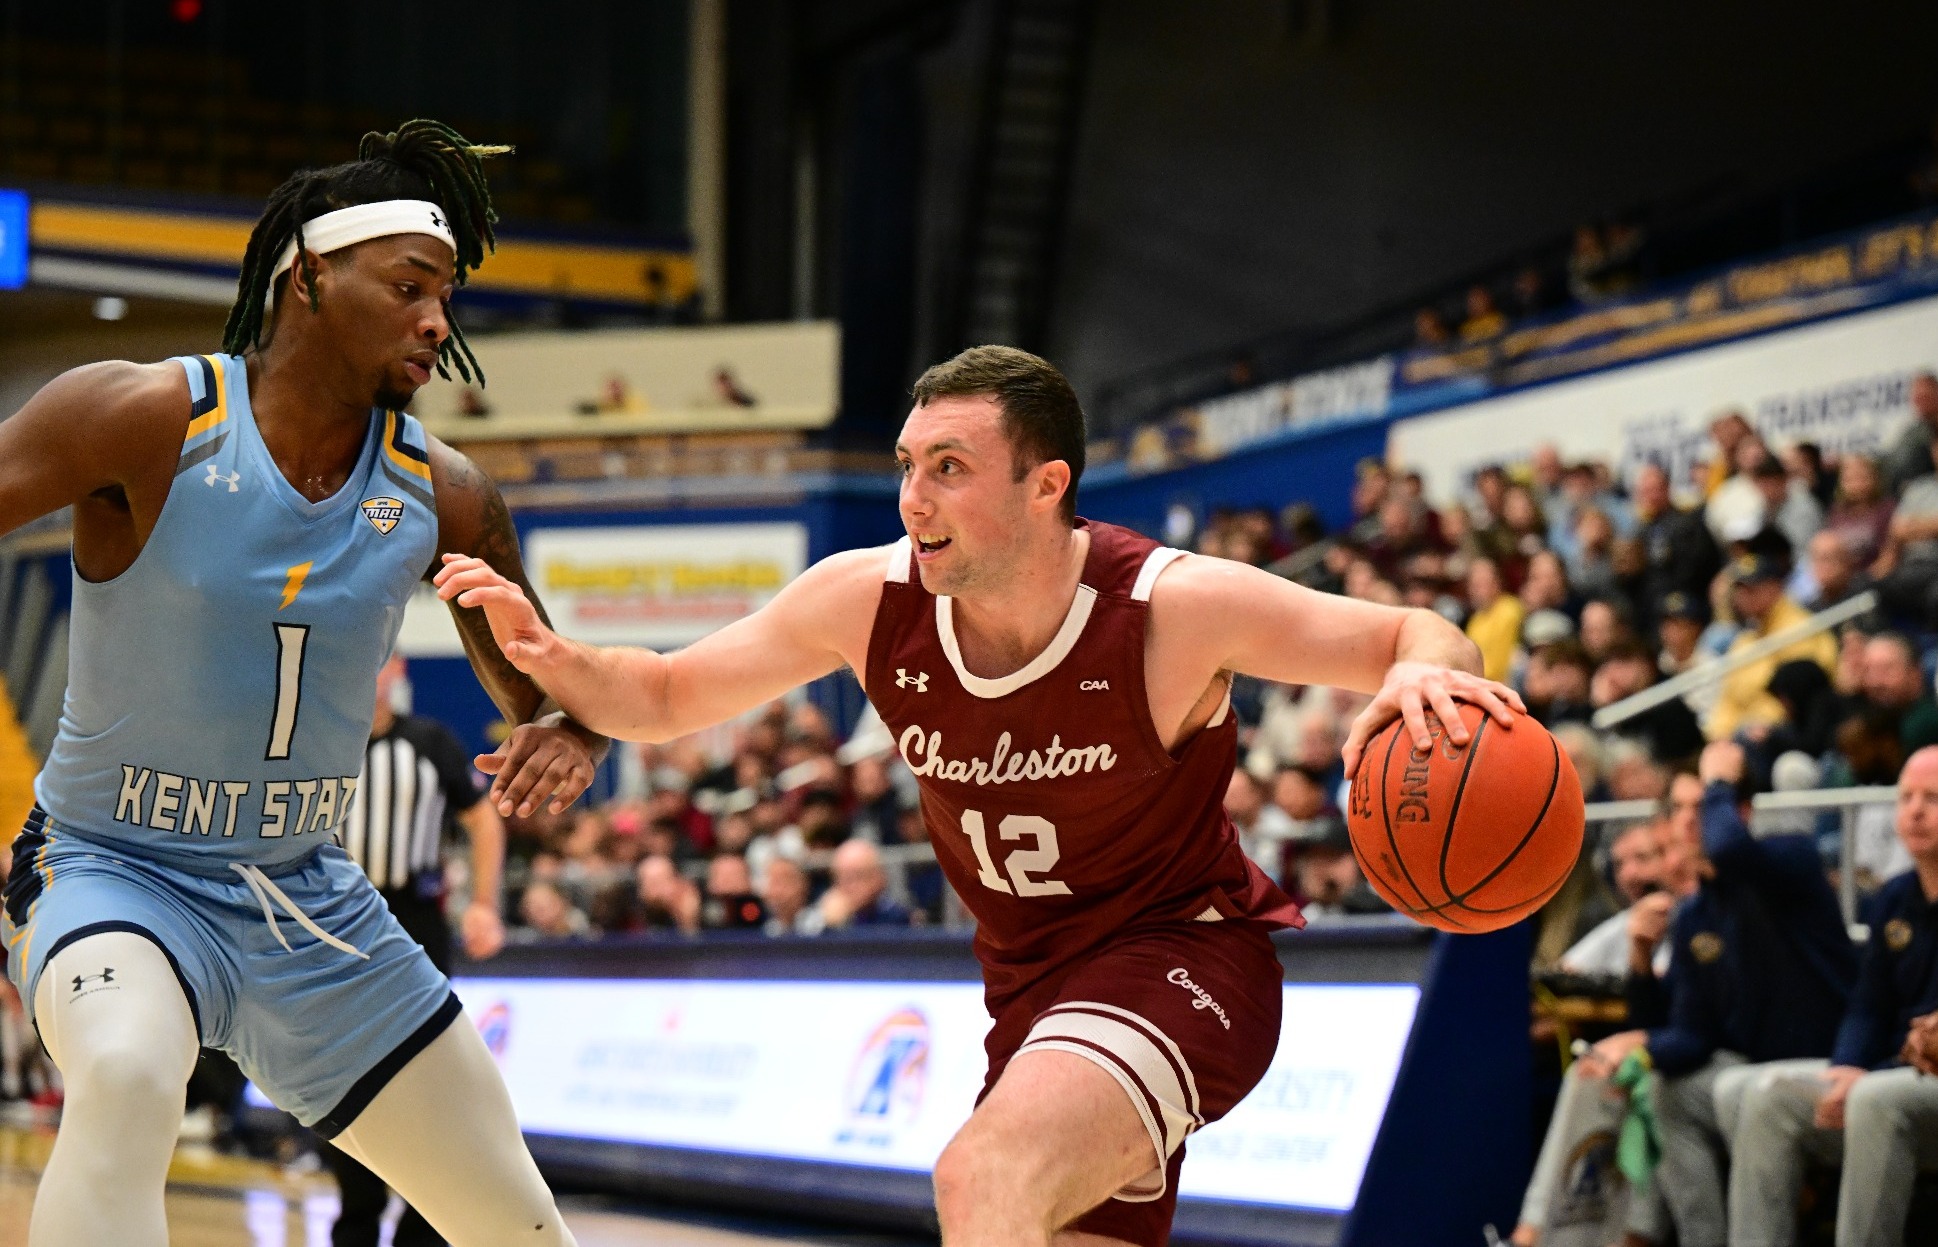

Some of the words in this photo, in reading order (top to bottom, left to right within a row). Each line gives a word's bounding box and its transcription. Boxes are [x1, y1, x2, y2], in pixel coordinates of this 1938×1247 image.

[364, 507, 402, 519] MAC
[265, 621, 310, 761] 1
[1079, 680, 1110, 691] CAA
[900, 724, 1117, 786] Charleston
[113, 763, 251, 837] KENT
[258, 776, 359, 838] STAT
[960, 808, 1073, 898] 12
[1166, 967, 1231, 1030] Cougars
